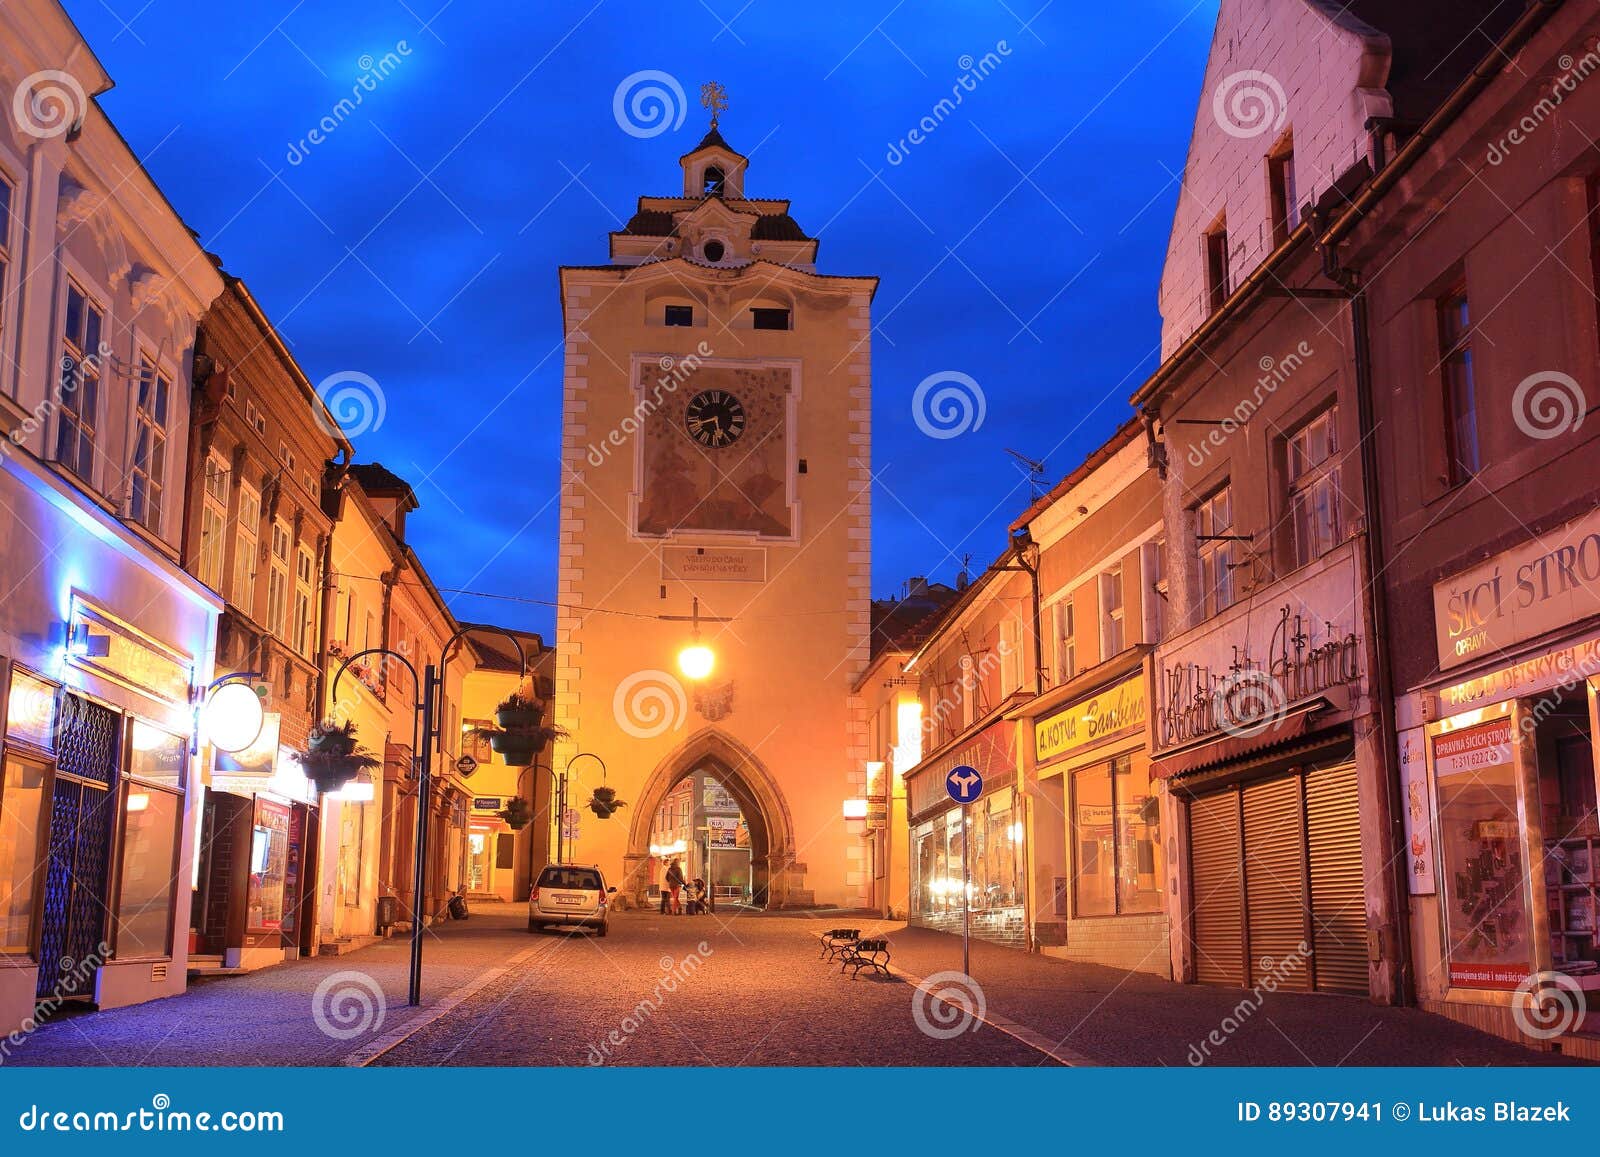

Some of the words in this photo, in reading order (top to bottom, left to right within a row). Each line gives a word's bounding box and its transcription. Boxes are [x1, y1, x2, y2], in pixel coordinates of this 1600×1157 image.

[1448, 566, 1505, 638] ŠICÍ
[1455, 631, 1488, 656] OPRAVY
[1086, 688, 1145, 738] Bambino
[1047, 716, 1078, 748] KOTVA
[1436, 738, 1466, 756] OPRAVNA
